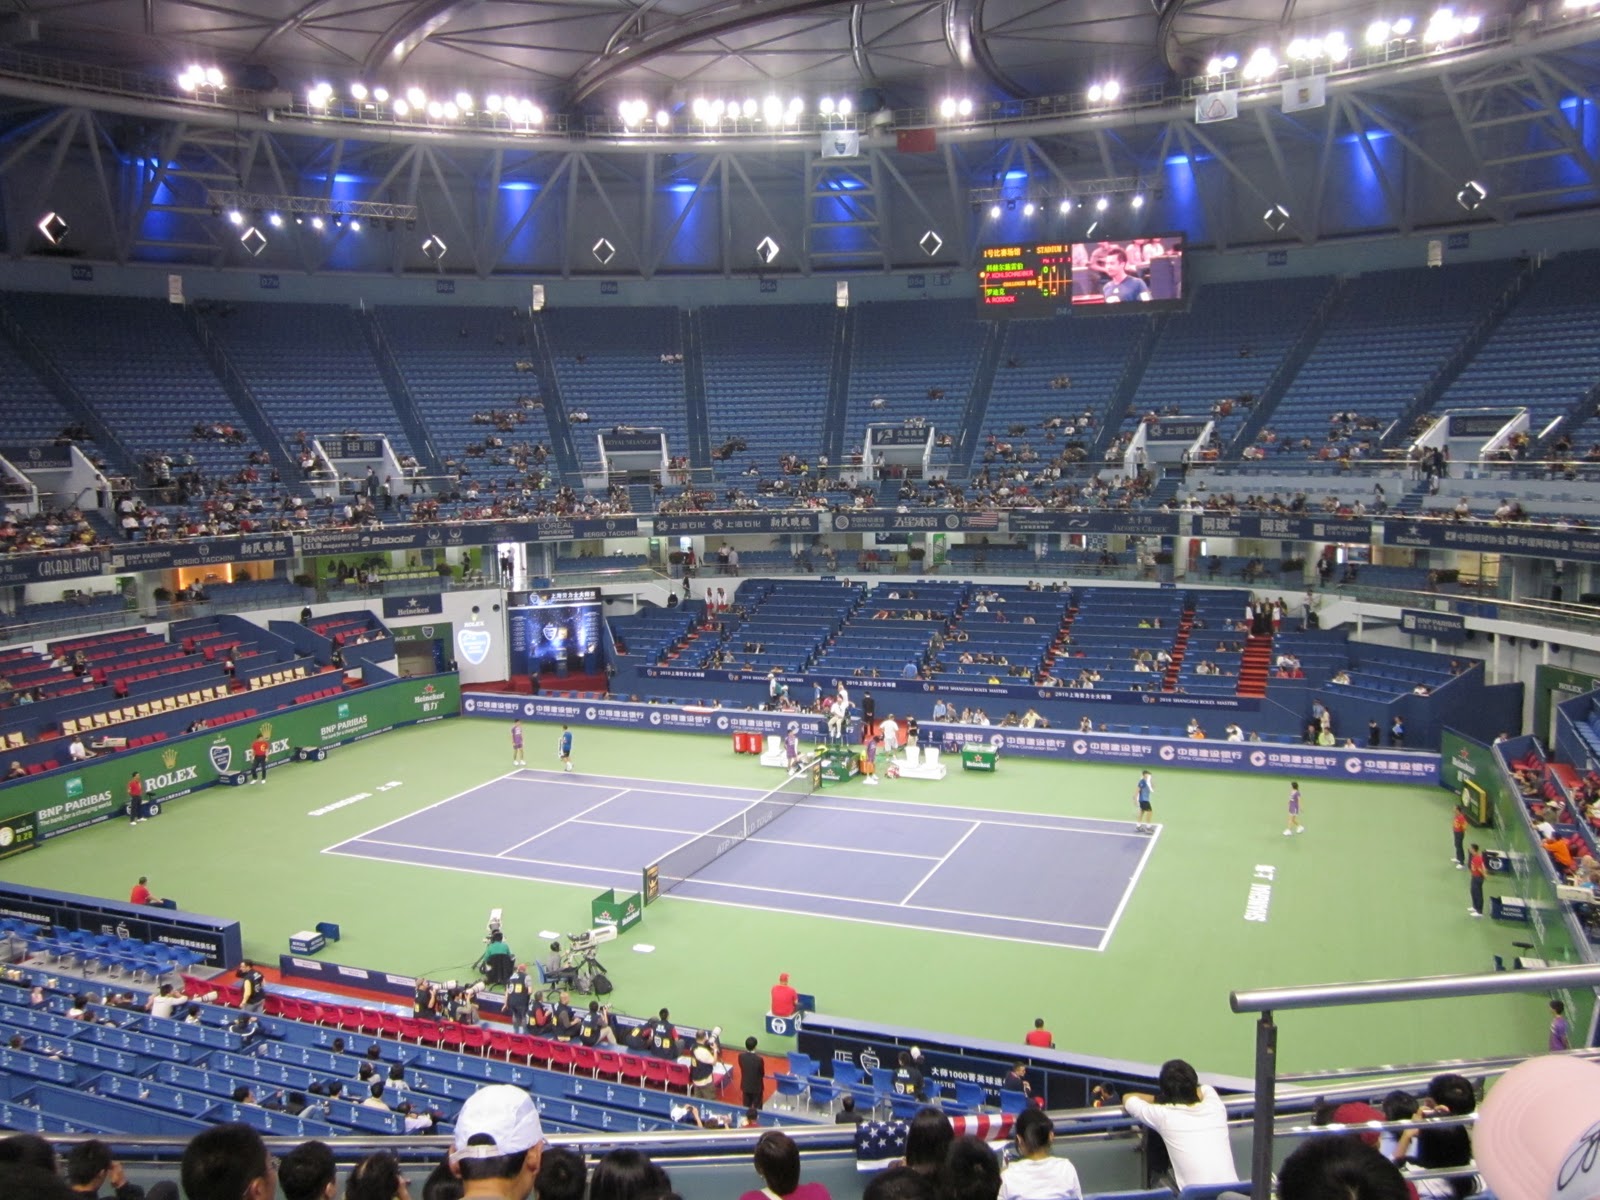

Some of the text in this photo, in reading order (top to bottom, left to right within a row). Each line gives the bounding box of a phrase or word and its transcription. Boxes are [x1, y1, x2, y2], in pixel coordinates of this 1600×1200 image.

[1036, 246, 1062, 254] STADIUM
[372, 535, 416, 545] Babolat
[39, 556, 99, 576] CASABLANCA
[398, 607, 430, 616] Heineken
[414, 692, 445, 703] Heineken
[477, 701, 519, 709] 中国建设银行
[536, 705, 580, 714] 中国建设银行
[598, 710, 644, 719] 中国建设银行
[663, 714, 710, 723] 中国建设银行
[338, 715, 367, 730] PARIBAS
[731, 719, 780, 728] 中国建设银行
[1006, 737, 1065, 748] 中国建设银行
[1090, 742, 1151, 754] 中国建设银行
[245, 738, 290, 762] RLEX
[1178, 748, 1242, 759] 中国建设银行
[1268, 754, 1336, 766] 中国建设银行
[1365, 760, 1435, 772] 中国建设银行
[145, 765, 198, 792] ROLEX
[65, 791, 112, 811] PARIBAS
